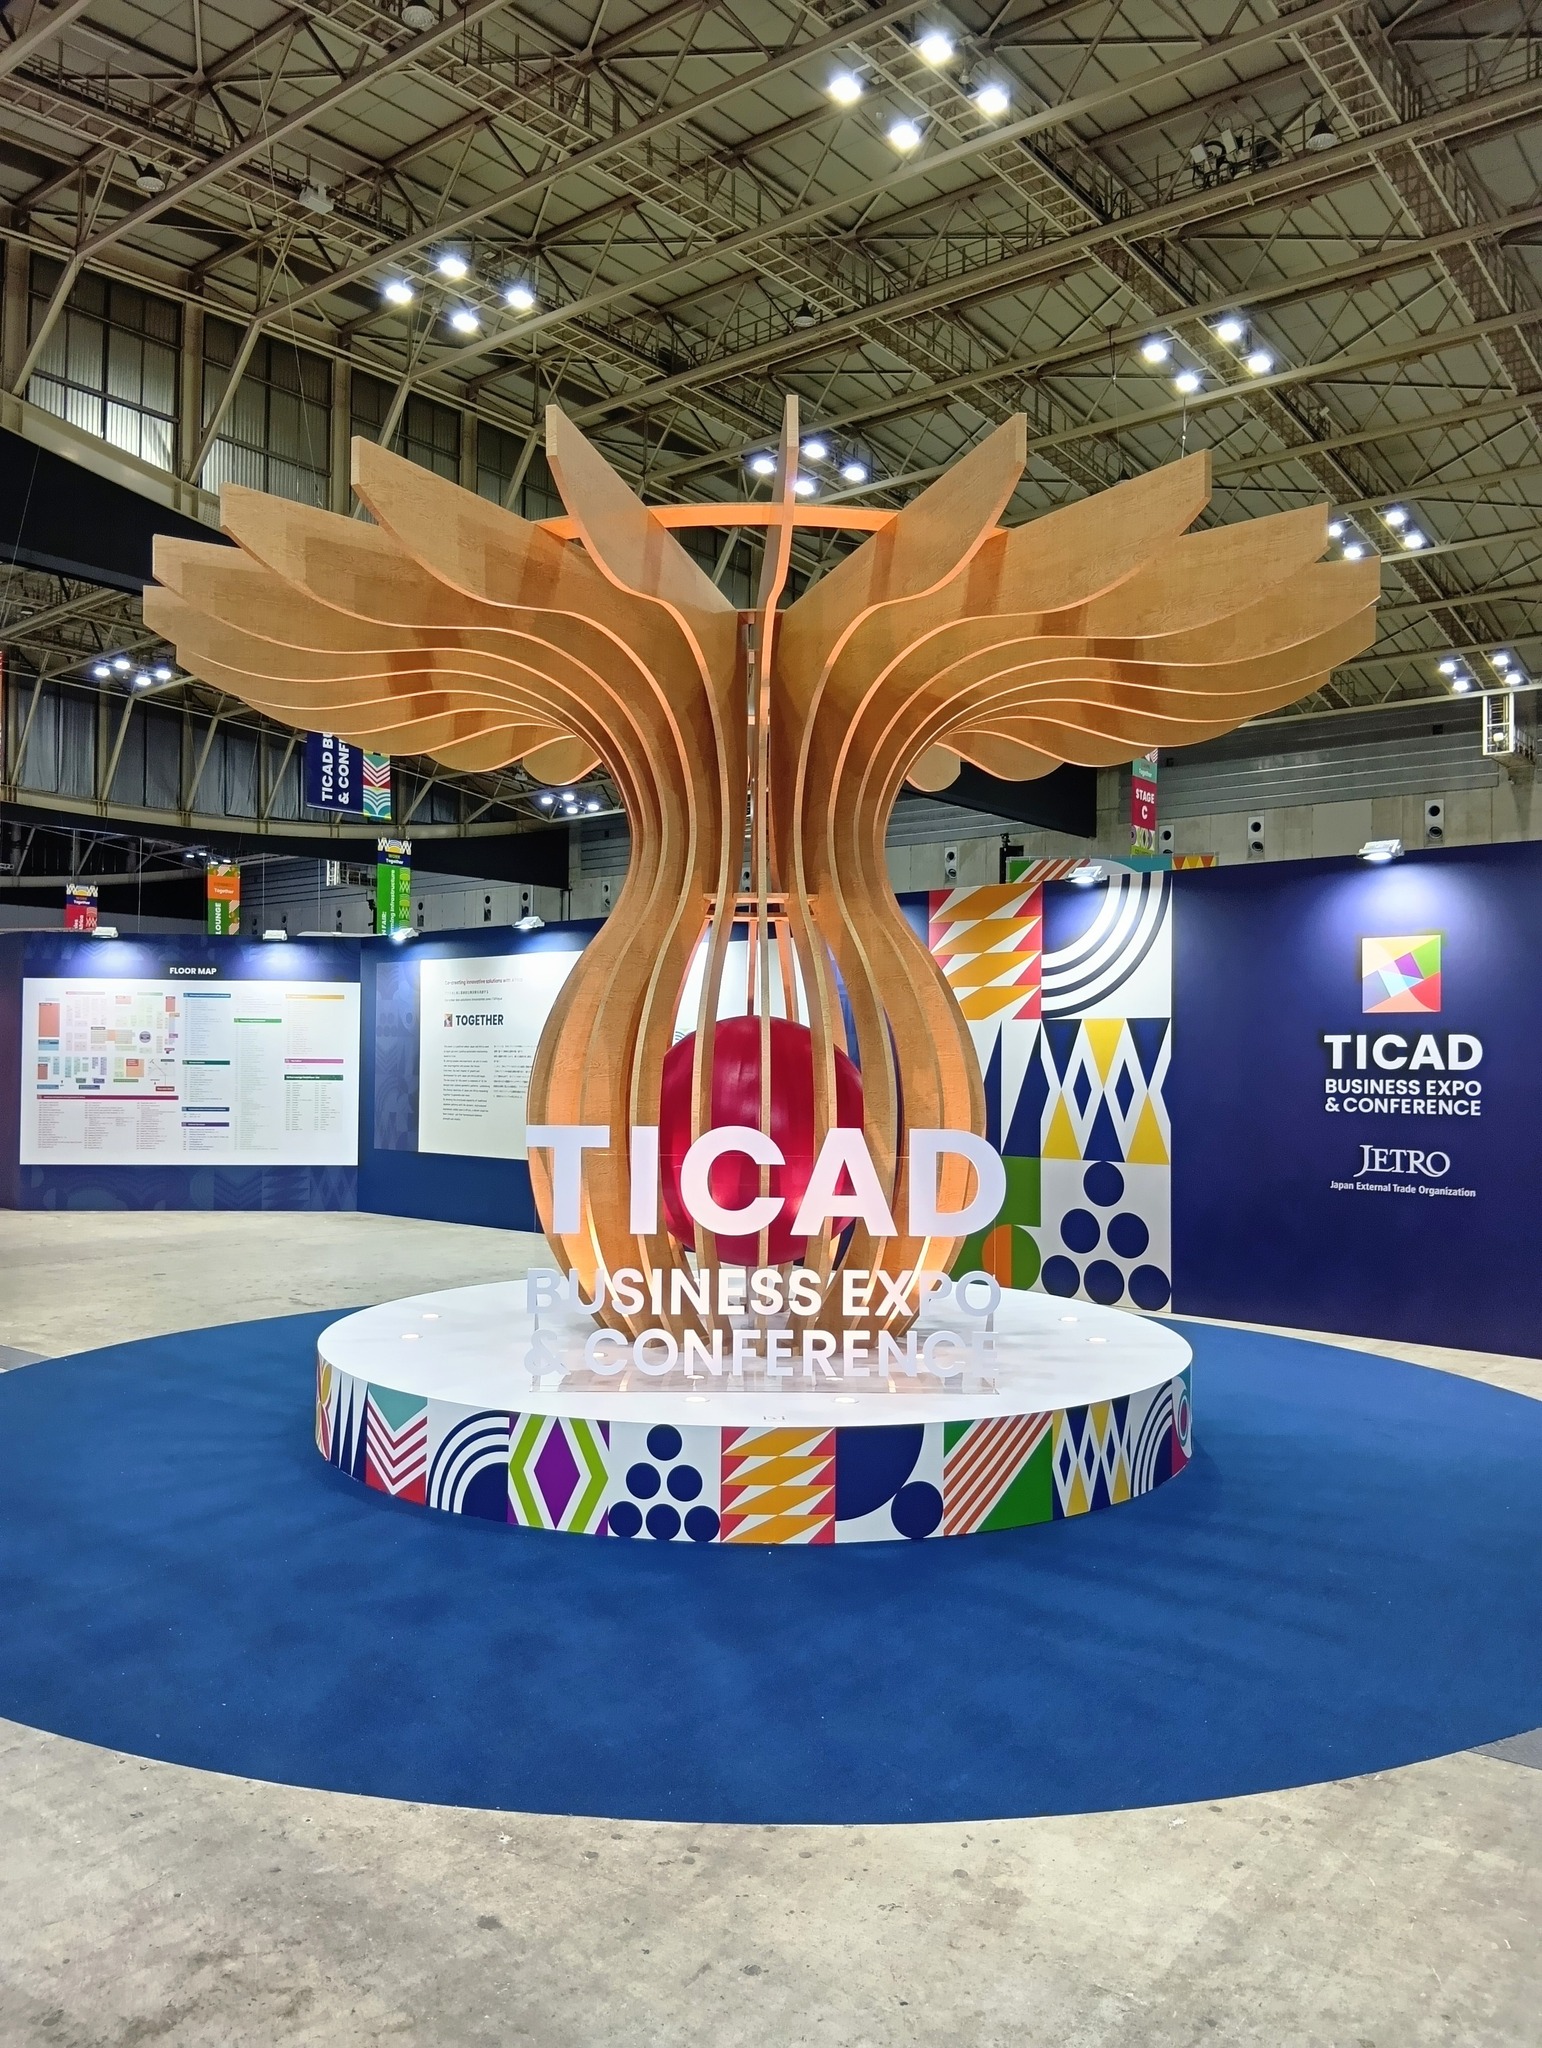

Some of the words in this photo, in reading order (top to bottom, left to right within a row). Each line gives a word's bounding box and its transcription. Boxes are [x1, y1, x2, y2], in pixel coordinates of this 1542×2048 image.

[338, 738, 350, 789] CONF
[322, 751, 334, 802] TICAD
[338, 792, 350, 805] &
[1136, 788, 1155, 804] STAGE
[1142, 805, 1148, 819] C
[214, 887, 235, 895] Together
[169, 967, 197, 975] FLOOR
[198, 967, 217, 975] MAP
[455, 1014, 504, 1026] TOGETHER
[1323, 1034, 1484, 1071] TICAD
[1325, 1079, 1421, 1096] BUSINESS
[1426, 1080, 1482, 1097] EXPO
[1325, 1097, 1341, 1112] &
[1343, 1097, 1482, 1116] CONFERENCE
[1353, 1144, 1451, 1178] JETRO
[526, 1125, 1007, 1237] TICAD
[1330, 1180, 1354, 1191] Japan
[1356, 1181, 1391, 1193] External
[1392, 1183, 1416, 1194] Trade
[1418, 1185, 1476, 1198] Organization
[526, 1267, 823, 1317] BUSINESS
[842, 1269, 1002, 1318] EXPO
[523, 1328, 573, 1377] &
[584, 1328, 1000, 1379] CONFERENCE
